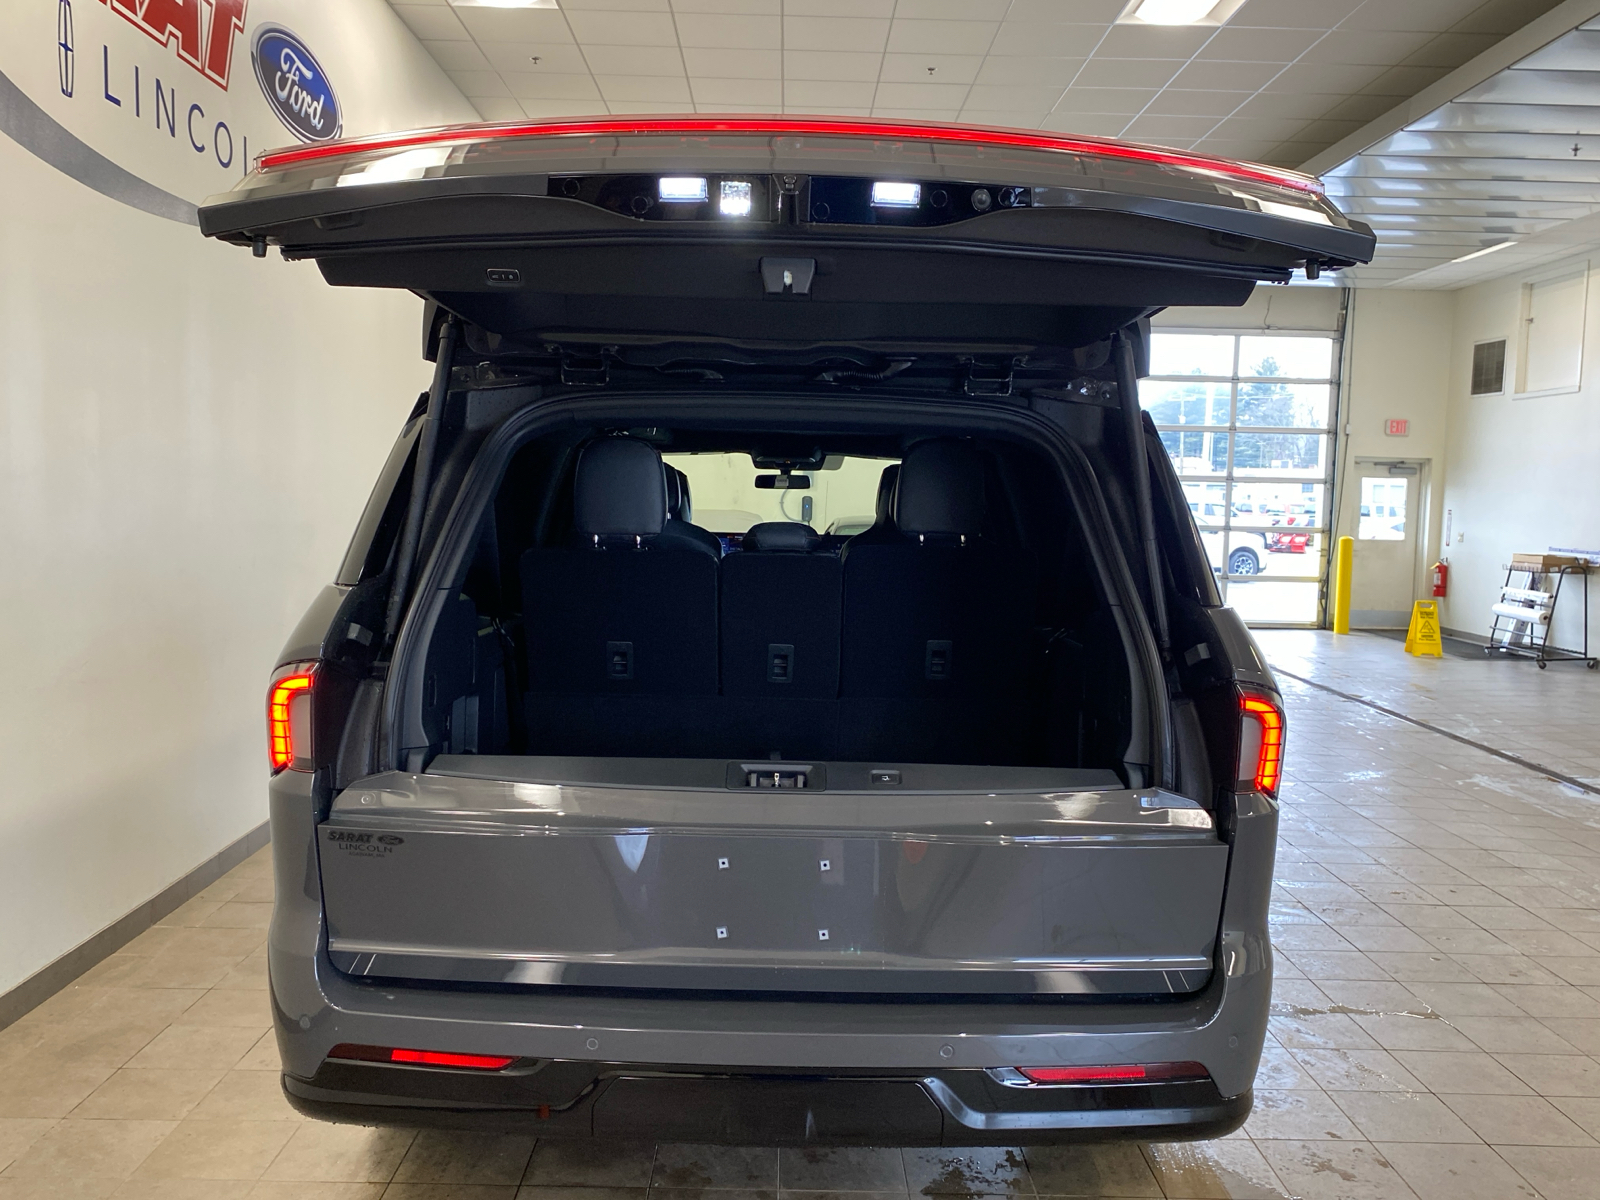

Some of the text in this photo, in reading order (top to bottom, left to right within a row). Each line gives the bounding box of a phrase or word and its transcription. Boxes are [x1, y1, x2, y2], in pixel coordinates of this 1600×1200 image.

[275, 47, 325, 130] Ford
[1390, 419, 1407, 434] EXIT
[328, 831, 374, 843] SARAT
[338, 844, 393, 853] LINCOLN
